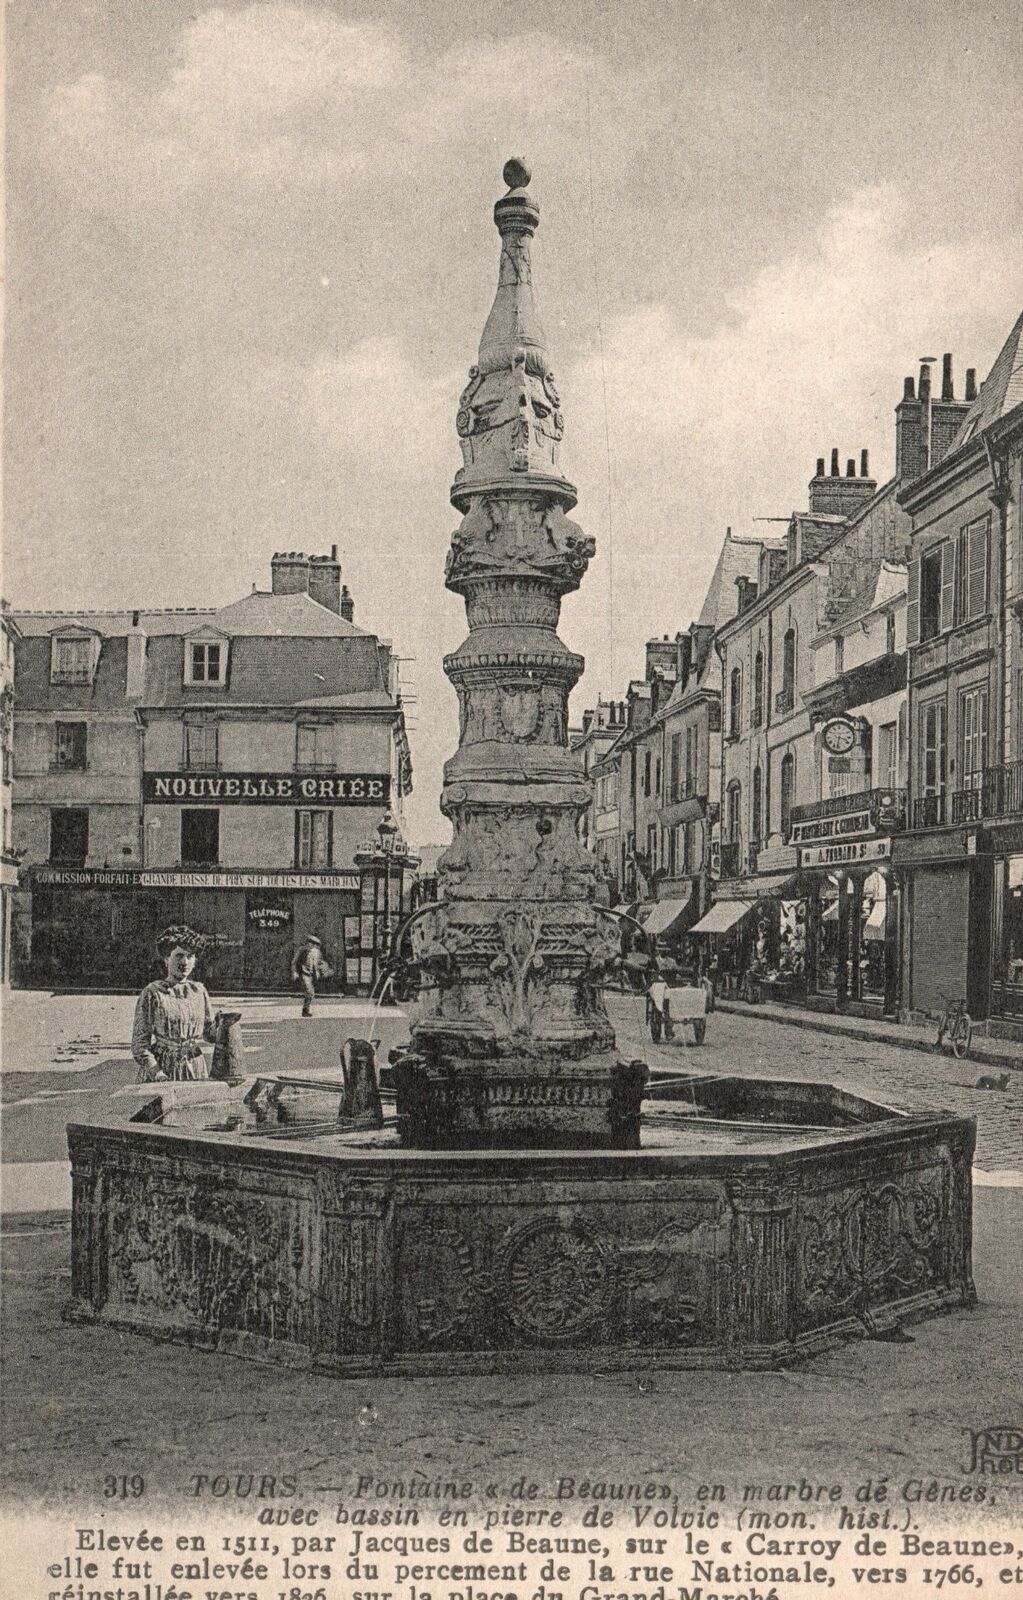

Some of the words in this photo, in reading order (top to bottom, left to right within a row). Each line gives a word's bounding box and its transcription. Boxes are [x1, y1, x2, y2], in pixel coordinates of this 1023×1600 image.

[154, 778, 292, 797] NOUVELLE
[299, 777, 384, 798] CRIÉE
[36, 872, 91, 884] COMMISSION
[94, 873, 129, 884] FORFAIT
[143, 873, 176, 886] GRANDE
[180, 874, 209, 886] BAISSE
[212, 875, 222, 886] DE
[226, 875, 243, 886] PRIX
[248, 876, 263, 886] SUR
[267, 876, 297, 887] TOUTES
[300, 877, 317, 887] LES
